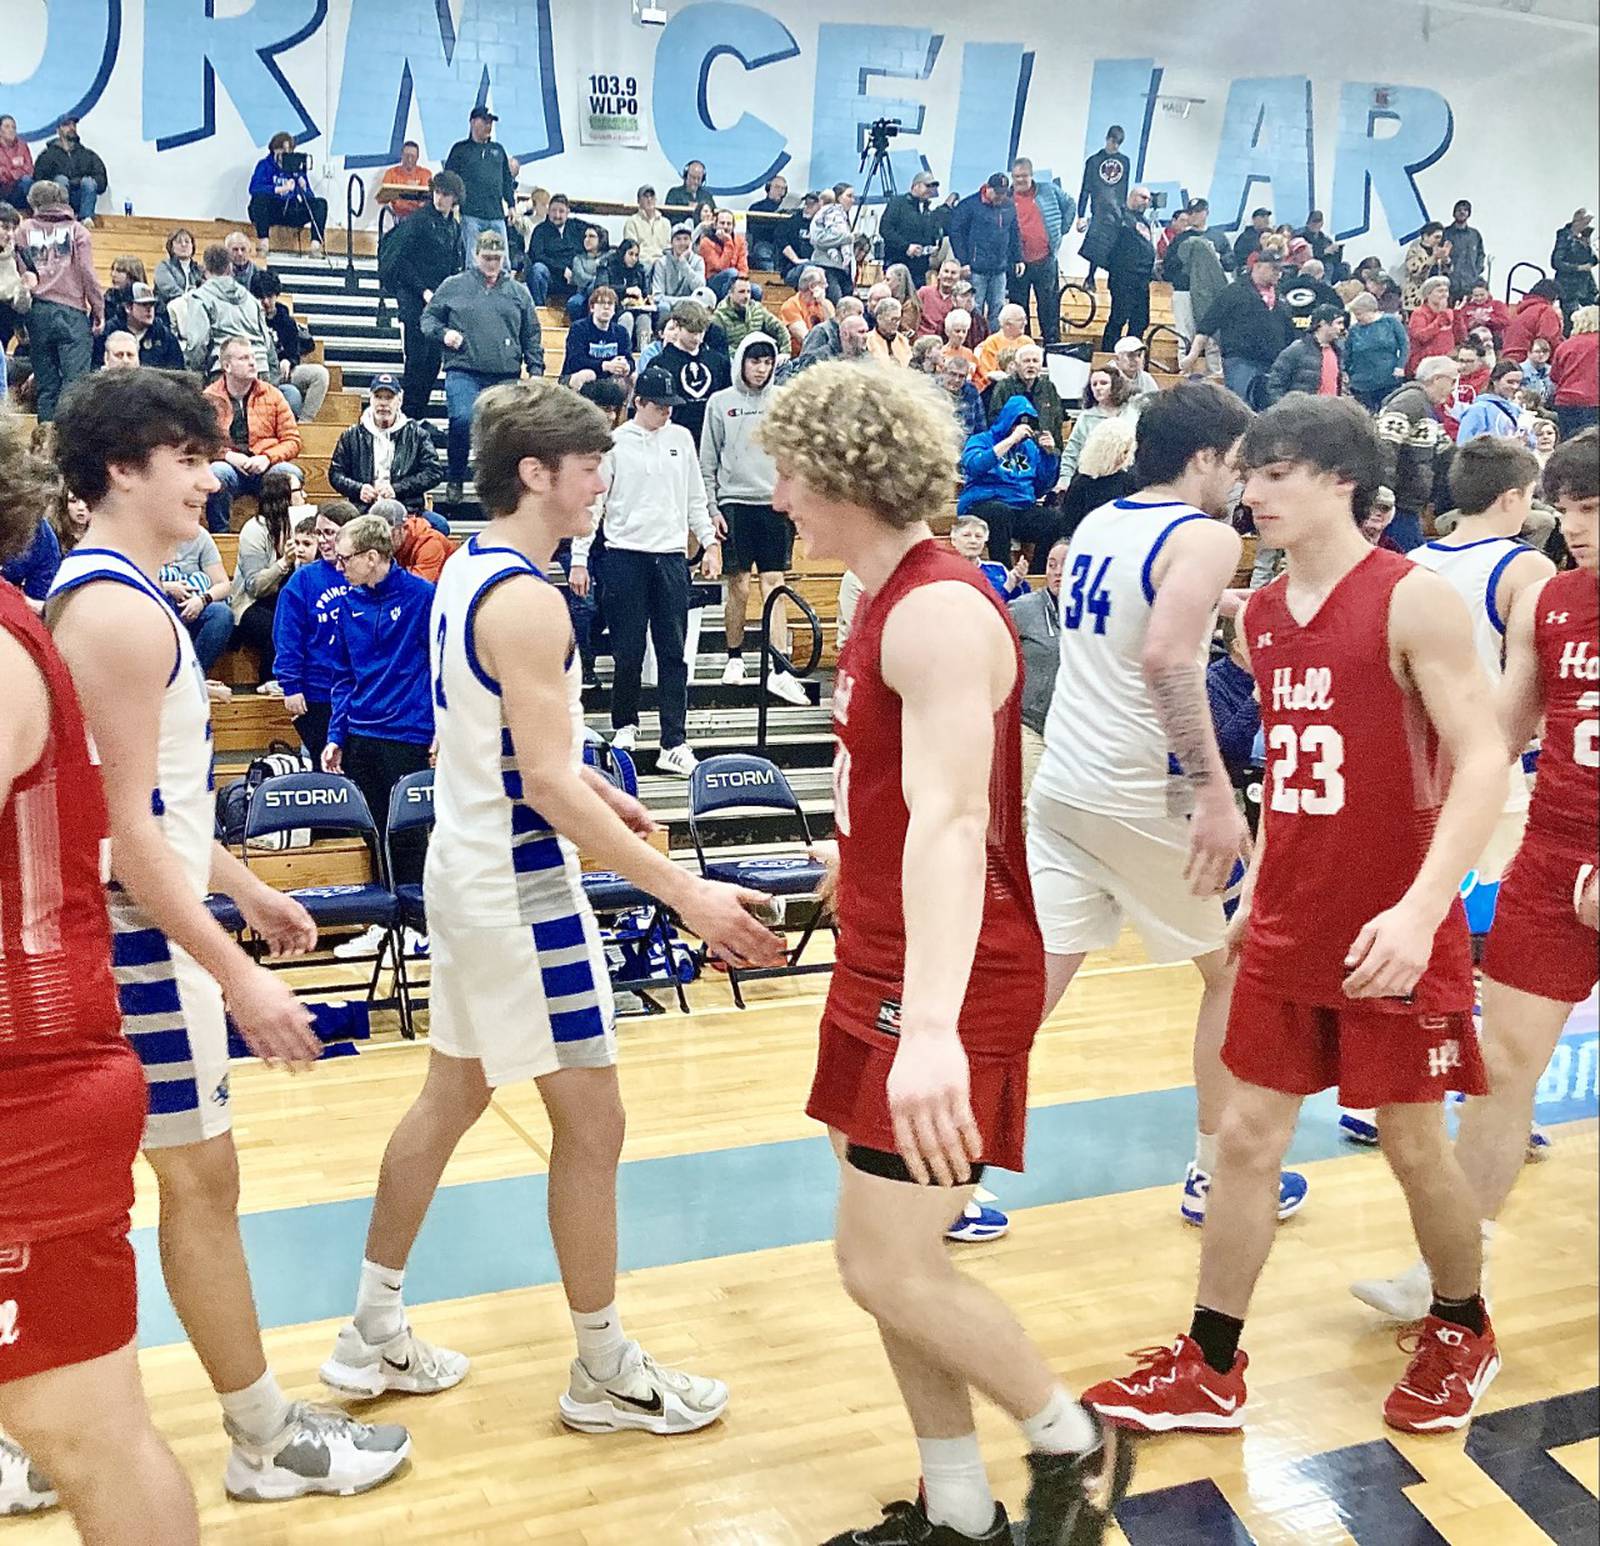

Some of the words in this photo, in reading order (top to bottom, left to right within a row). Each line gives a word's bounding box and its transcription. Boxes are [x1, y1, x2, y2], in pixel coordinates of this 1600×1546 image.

[588, 75, 637, 96] 103.9
[589, 95, 638, 115] WLPO
[653, 1, 1454, 246] CELLAR
[1065, 554, 1112, 635] 34
[1272, 667, 1334, 712] Hall
[706, 769, 775, 788] STORM
[1269, 724, 1345, 815] 23
[265, 788, 348, 807] STORM
